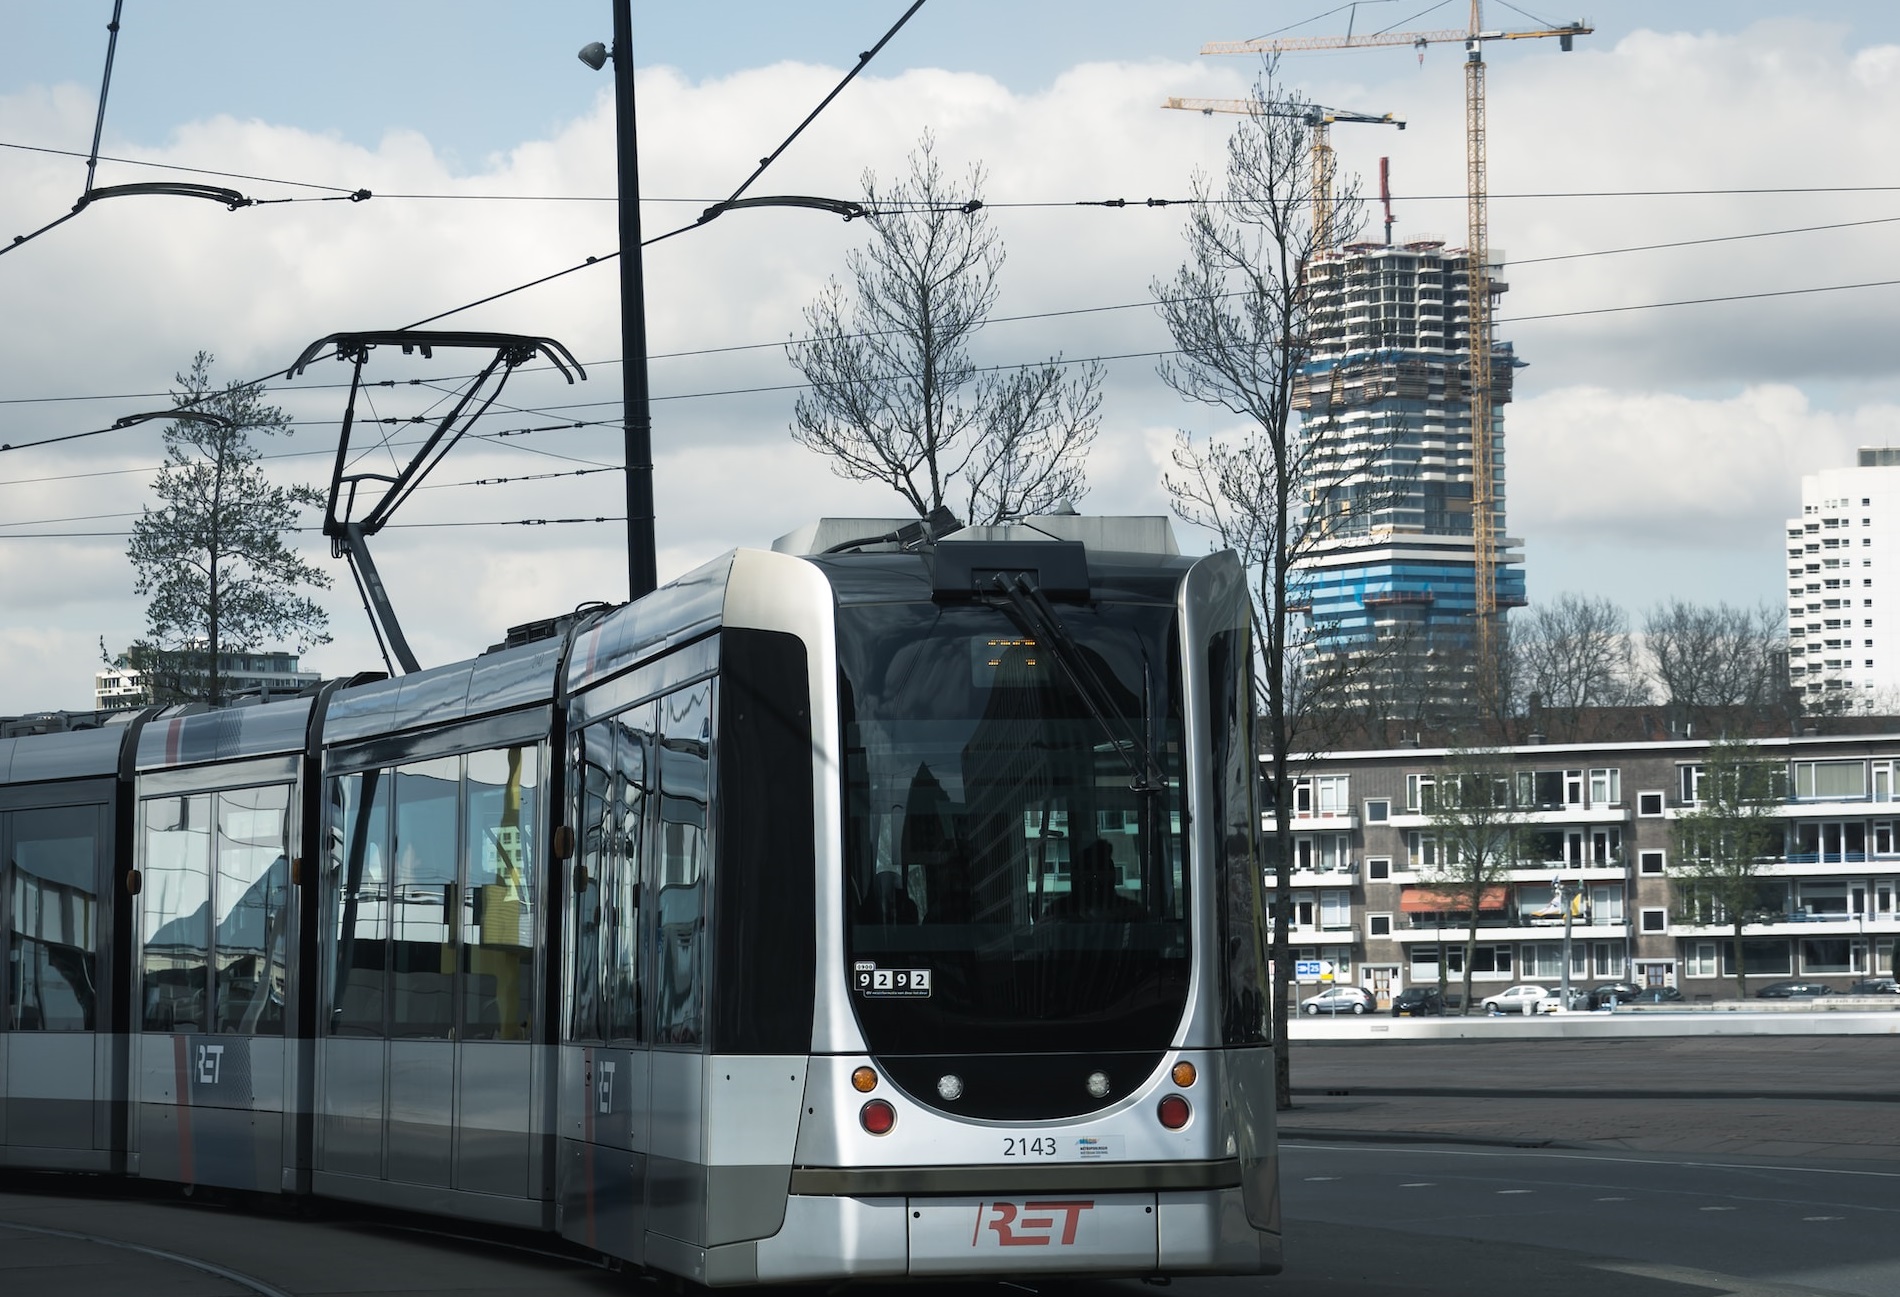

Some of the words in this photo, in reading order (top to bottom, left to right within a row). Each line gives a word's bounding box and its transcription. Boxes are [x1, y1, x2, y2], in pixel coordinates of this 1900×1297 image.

[193, 1044, 225, 1084] RET
[596, 1060, 616, 1114] RET
[1003, 1137, 1057, 1156] 2143
[972, 1200, 1095, 1247] RET
